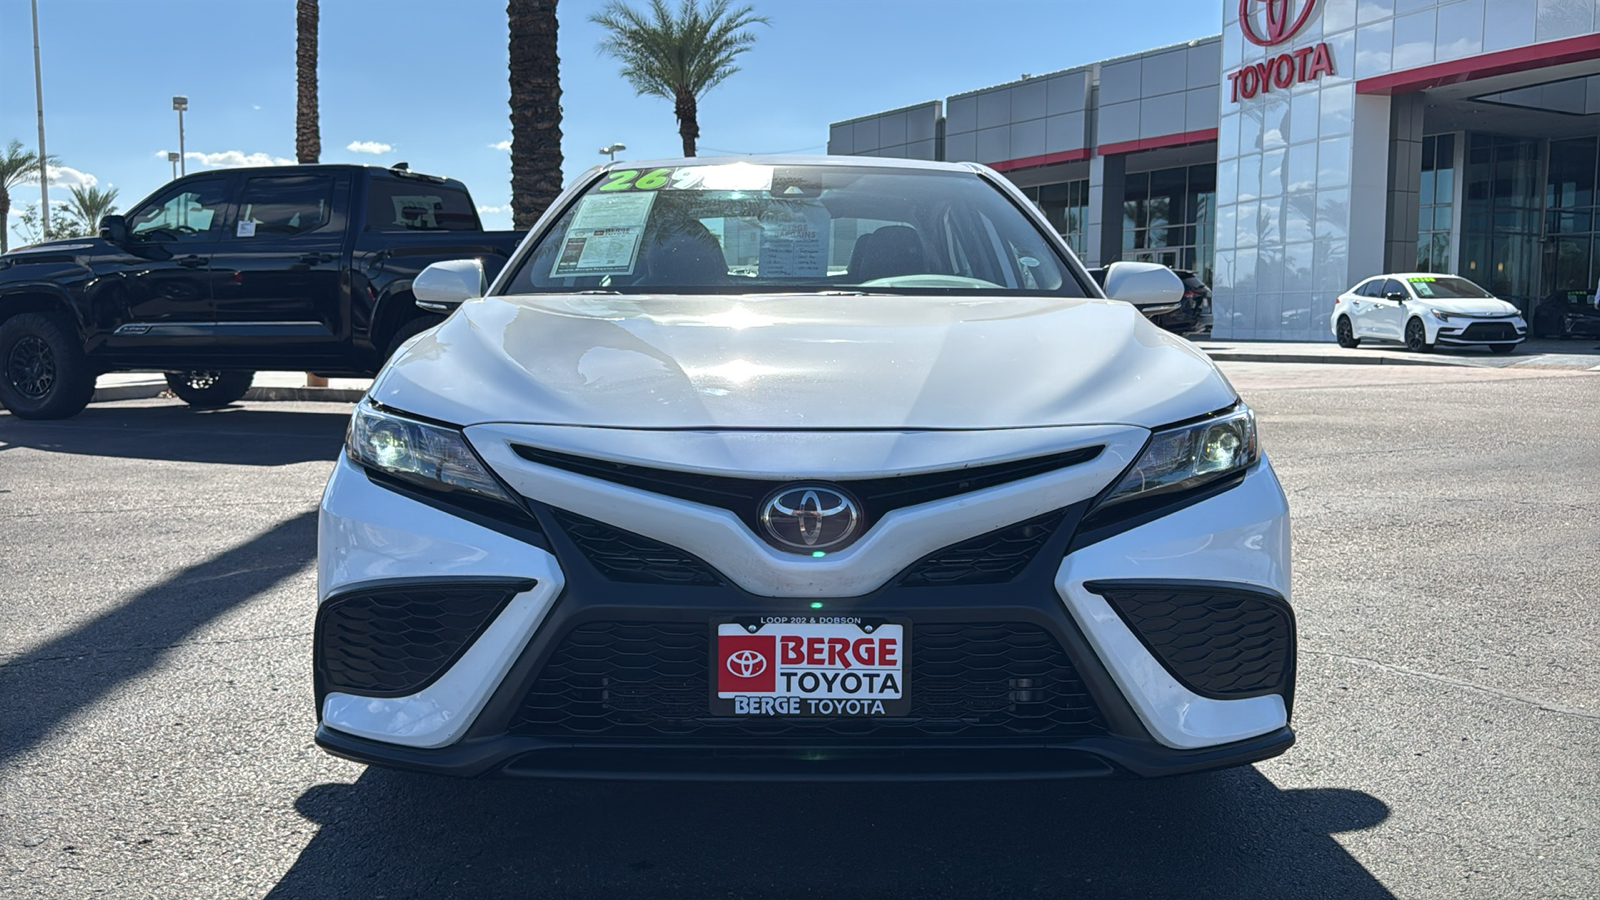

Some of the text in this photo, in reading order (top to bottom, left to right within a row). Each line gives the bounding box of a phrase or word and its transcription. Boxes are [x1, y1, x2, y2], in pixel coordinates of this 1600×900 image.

[1227, 42, 1334, 103] TOYOTA
[780, 635, 898, 669] BERGE
[780, 671, 900, 694] TOYOTA
[734, 696, 885, 716] BERGE TOYOTA
